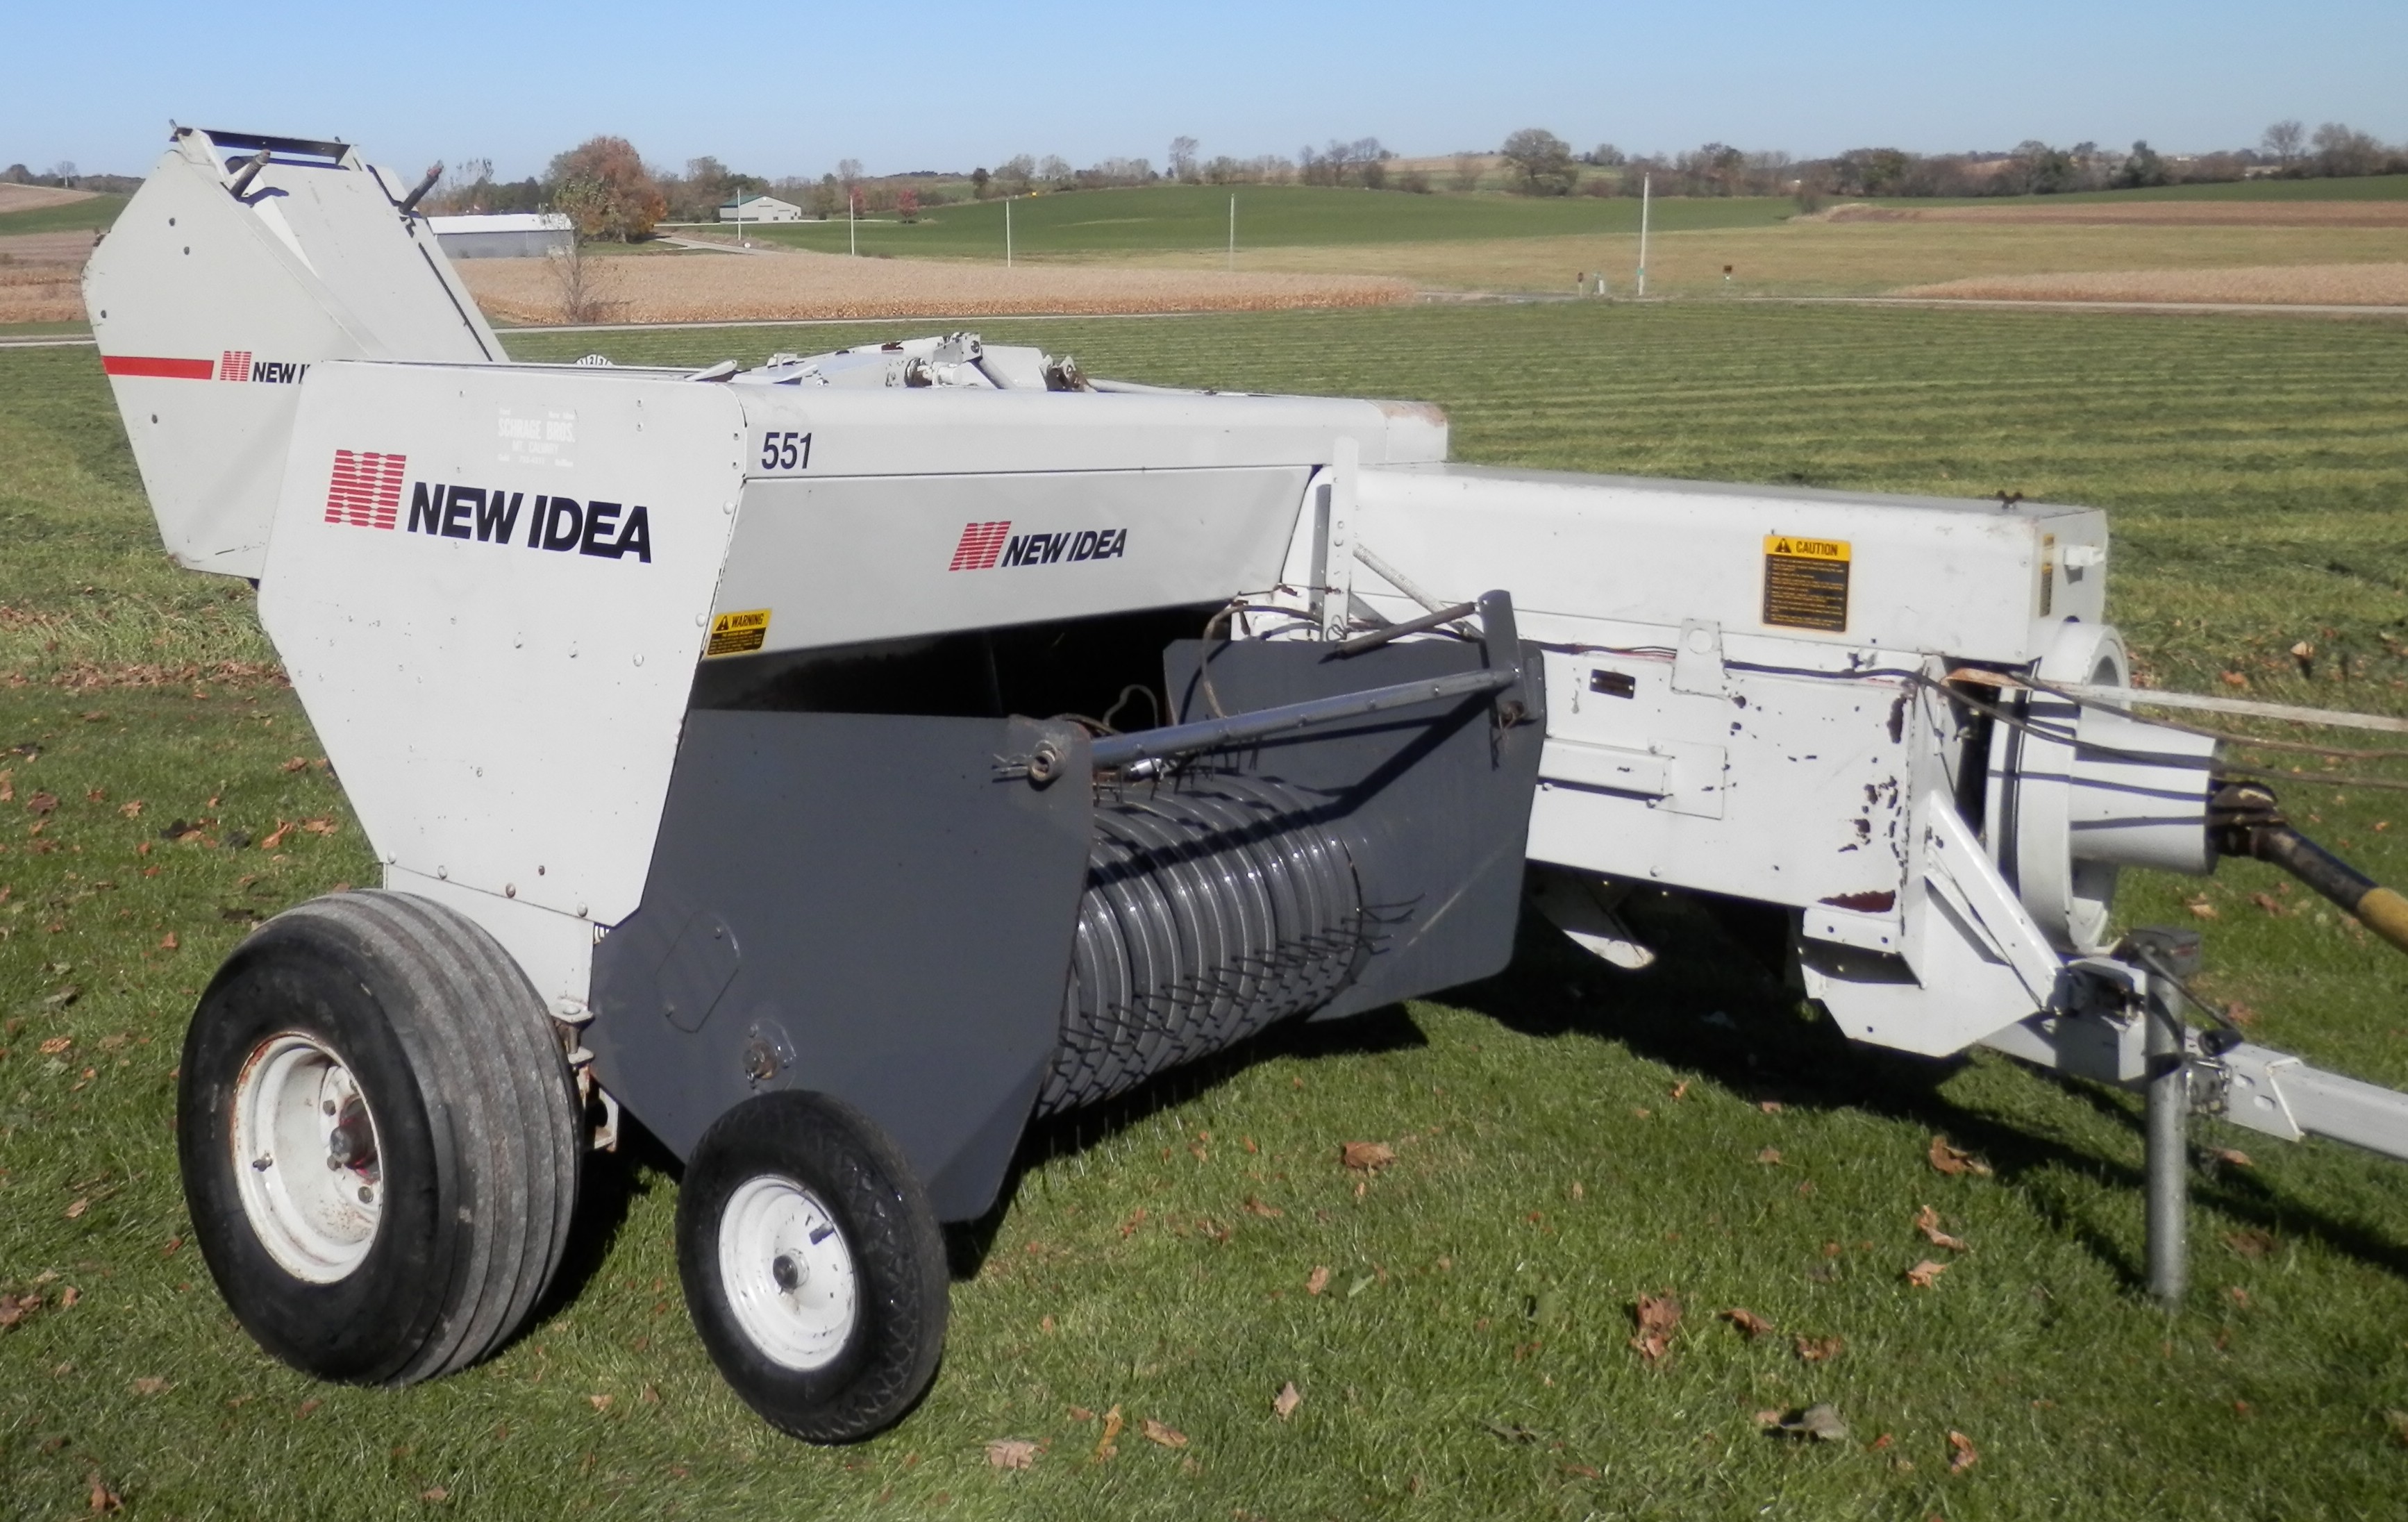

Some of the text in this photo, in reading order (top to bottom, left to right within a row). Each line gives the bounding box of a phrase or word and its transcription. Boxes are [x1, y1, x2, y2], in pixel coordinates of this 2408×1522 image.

[252, 362, 296, 383] NEW
[498, 417, 576, 443] SCHRAGE BROS.
[761, 432, 812, 469] 551
[408, 481, 524, 544] NEW
[528, 495, 651, 563] IDEA
[1001, 532, 1071, 567] NEW
[1066, 528, 1127, 562] IDEA
[1796, 540, 1838, 556] CAUTION
[731, 612, 764, 628] WARNING
